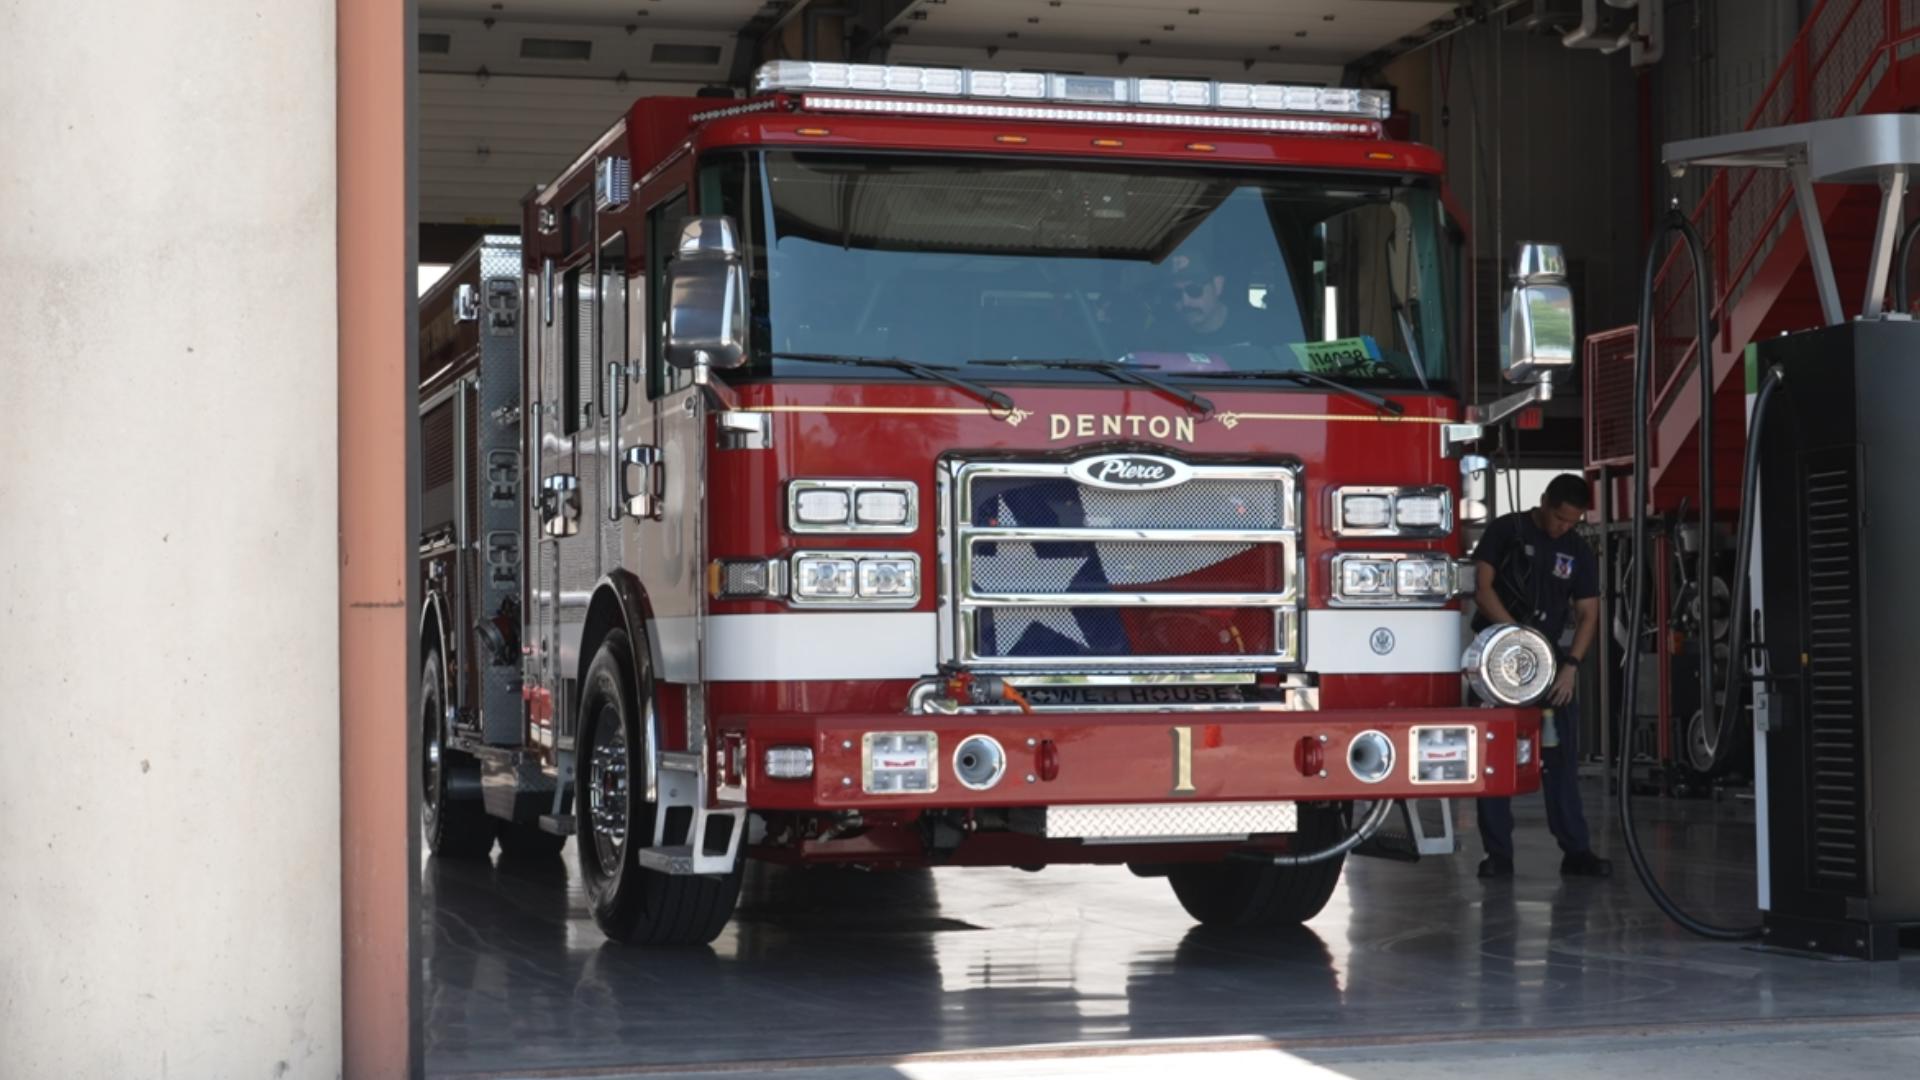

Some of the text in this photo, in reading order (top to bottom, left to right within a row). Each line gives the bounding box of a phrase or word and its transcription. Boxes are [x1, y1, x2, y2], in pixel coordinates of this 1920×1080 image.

[1050, 414, 1195, 443] DENTON
[1098, 459, 1165, 481] Pierce
[1017, 687, 1229, 703] OWER HOUSE
[1173, 726, 1197, 793] 1
